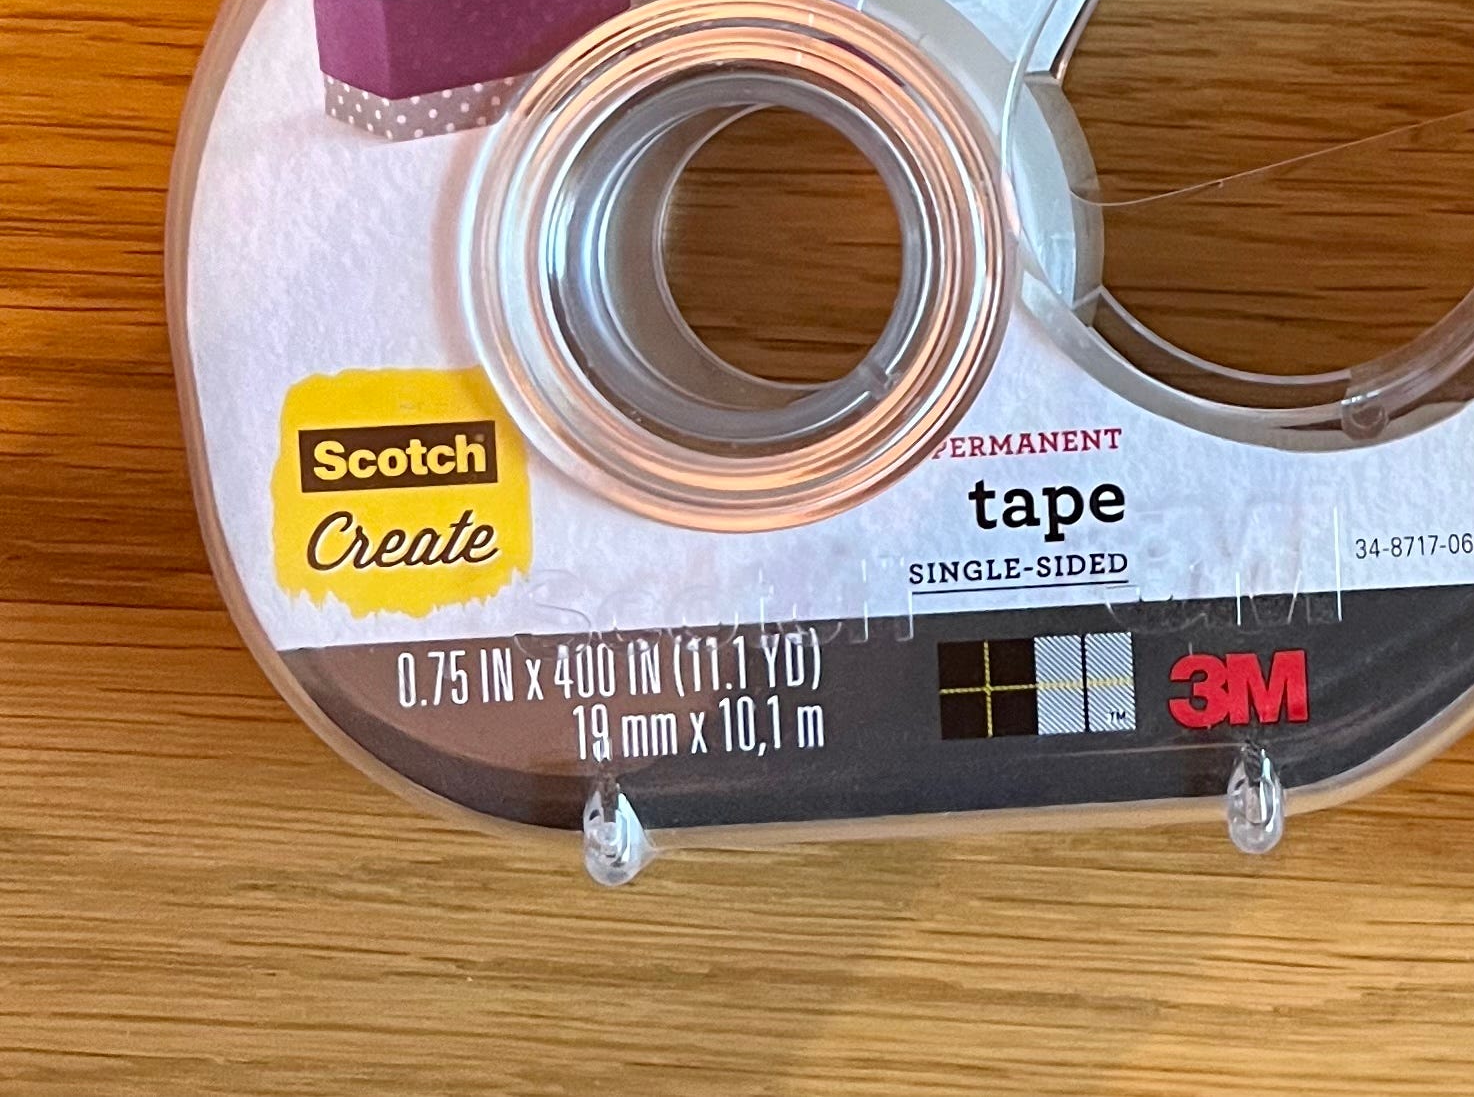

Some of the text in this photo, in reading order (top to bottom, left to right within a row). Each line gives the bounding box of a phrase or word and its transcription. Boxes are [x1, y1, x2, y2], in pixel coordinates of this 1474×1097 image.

[313, 433, 488, 482] Scotch
[306, 509, 499, 570] Create
[968, 479, 1126, 542] tape
[909, 553, 1129, 585] SINGLE-SIDED
[398, 627, 822, 708] 0.75 IN x 400 IN (11.1 YD)
[1167, 648, 1310, 731] 3M
[572, 695, 825, 761] 19 mm x 10,1 m
